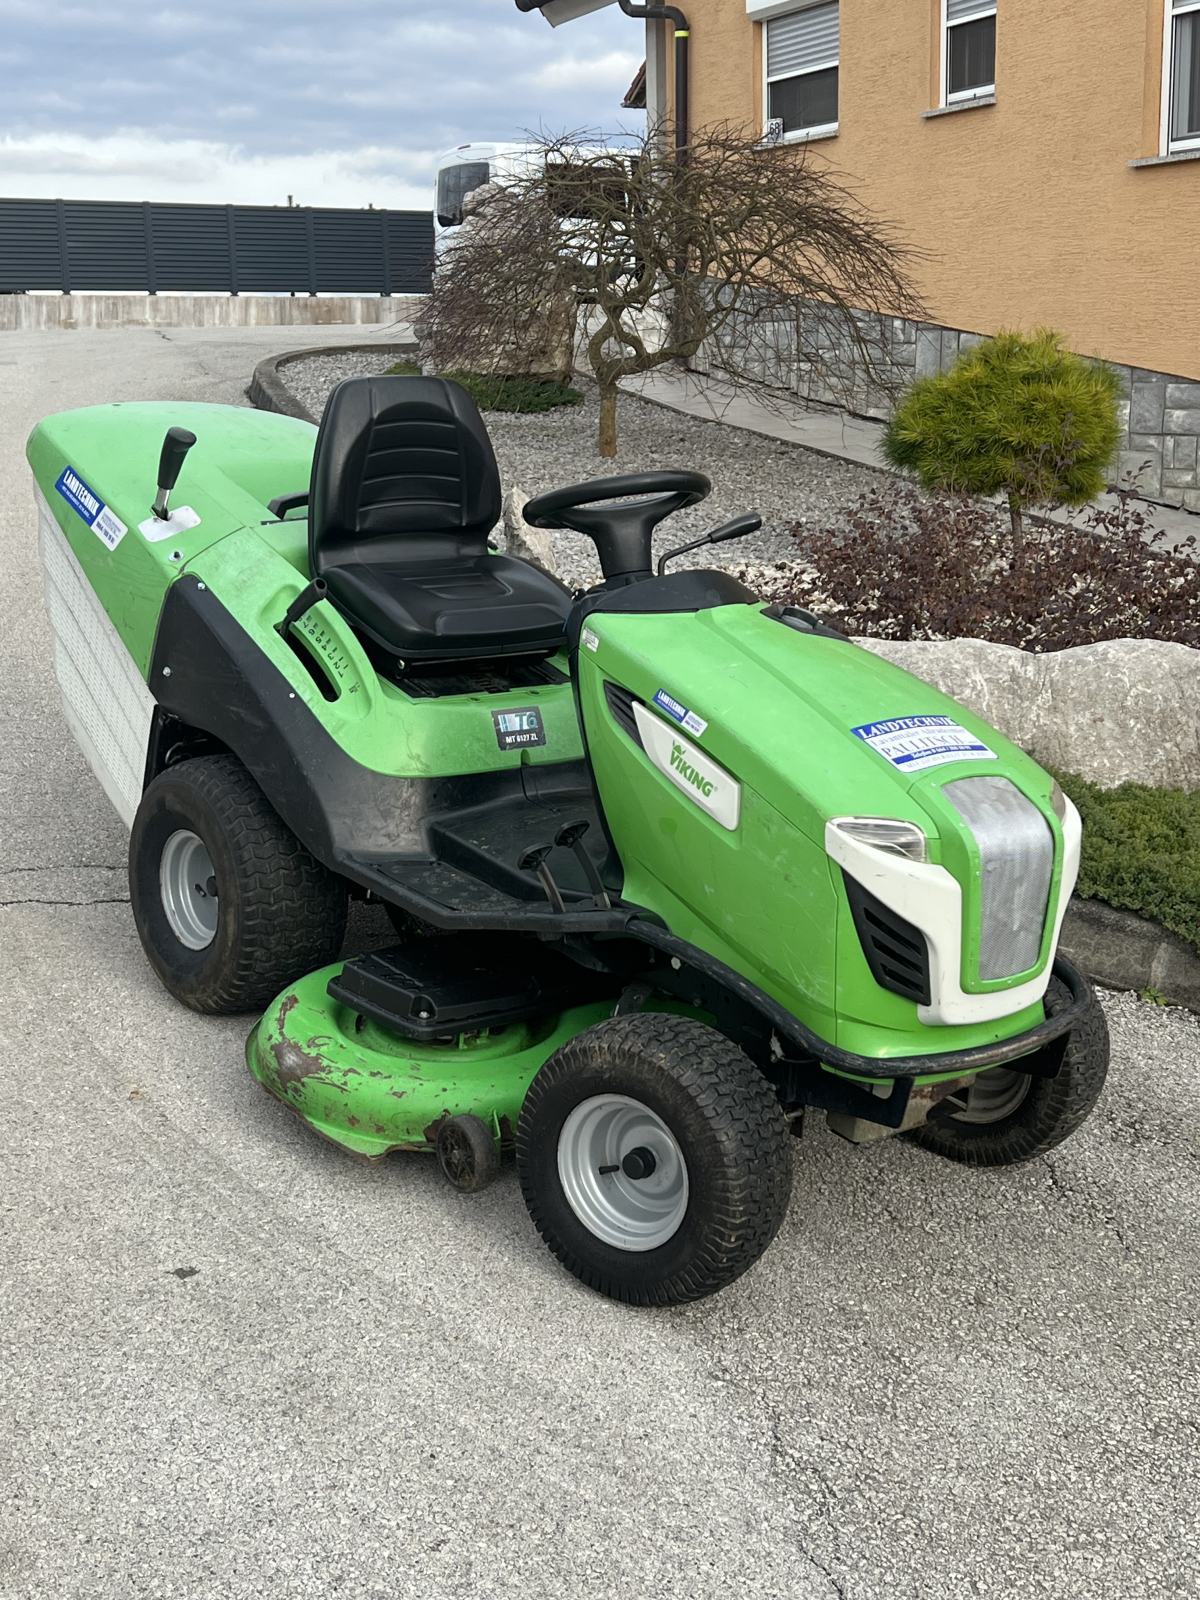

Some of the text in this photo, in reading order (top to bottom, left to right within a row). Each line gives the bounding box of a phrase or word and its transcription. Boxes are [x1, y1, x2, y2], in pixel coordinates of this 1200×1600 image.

[770, 121, 781, 136] 68
[63, 469, 101, 517] LANDTECHNIK
[657, 690, 687, 718] LANDTECHNIK
[505, 732, 539, 744] MT 6127 ZL
[857, 716, 957, 739] LANDTECHNIK
[669, 749, 714, 798] VIKING
